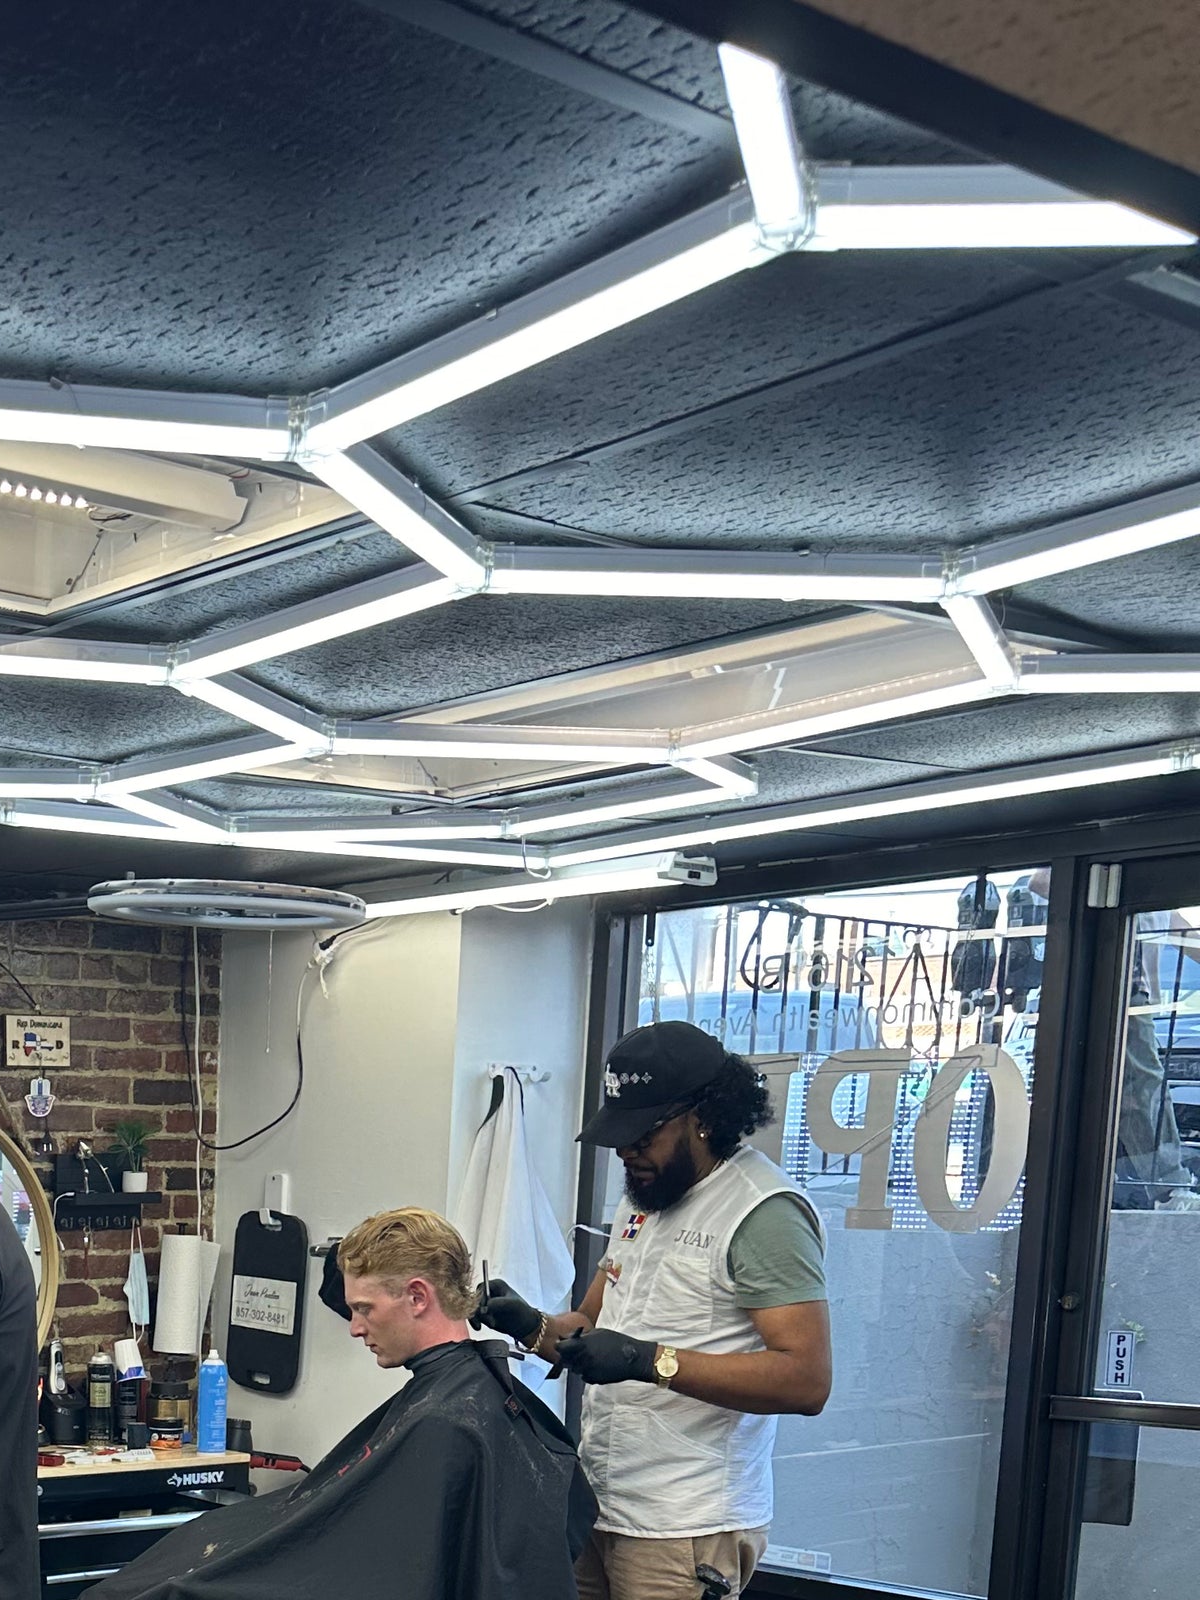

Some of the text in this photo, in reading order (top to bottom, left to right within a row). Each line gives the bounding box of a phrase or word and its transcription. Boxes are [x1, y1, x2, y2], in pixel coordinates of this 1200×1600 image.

[12, 1040, 64, 1050] R D
[674, 1229, 714, 1250] JUAN
[1114, 1335, 1126, 1383] PUSH
[182, 1471, 225, 1486] HUSKY
